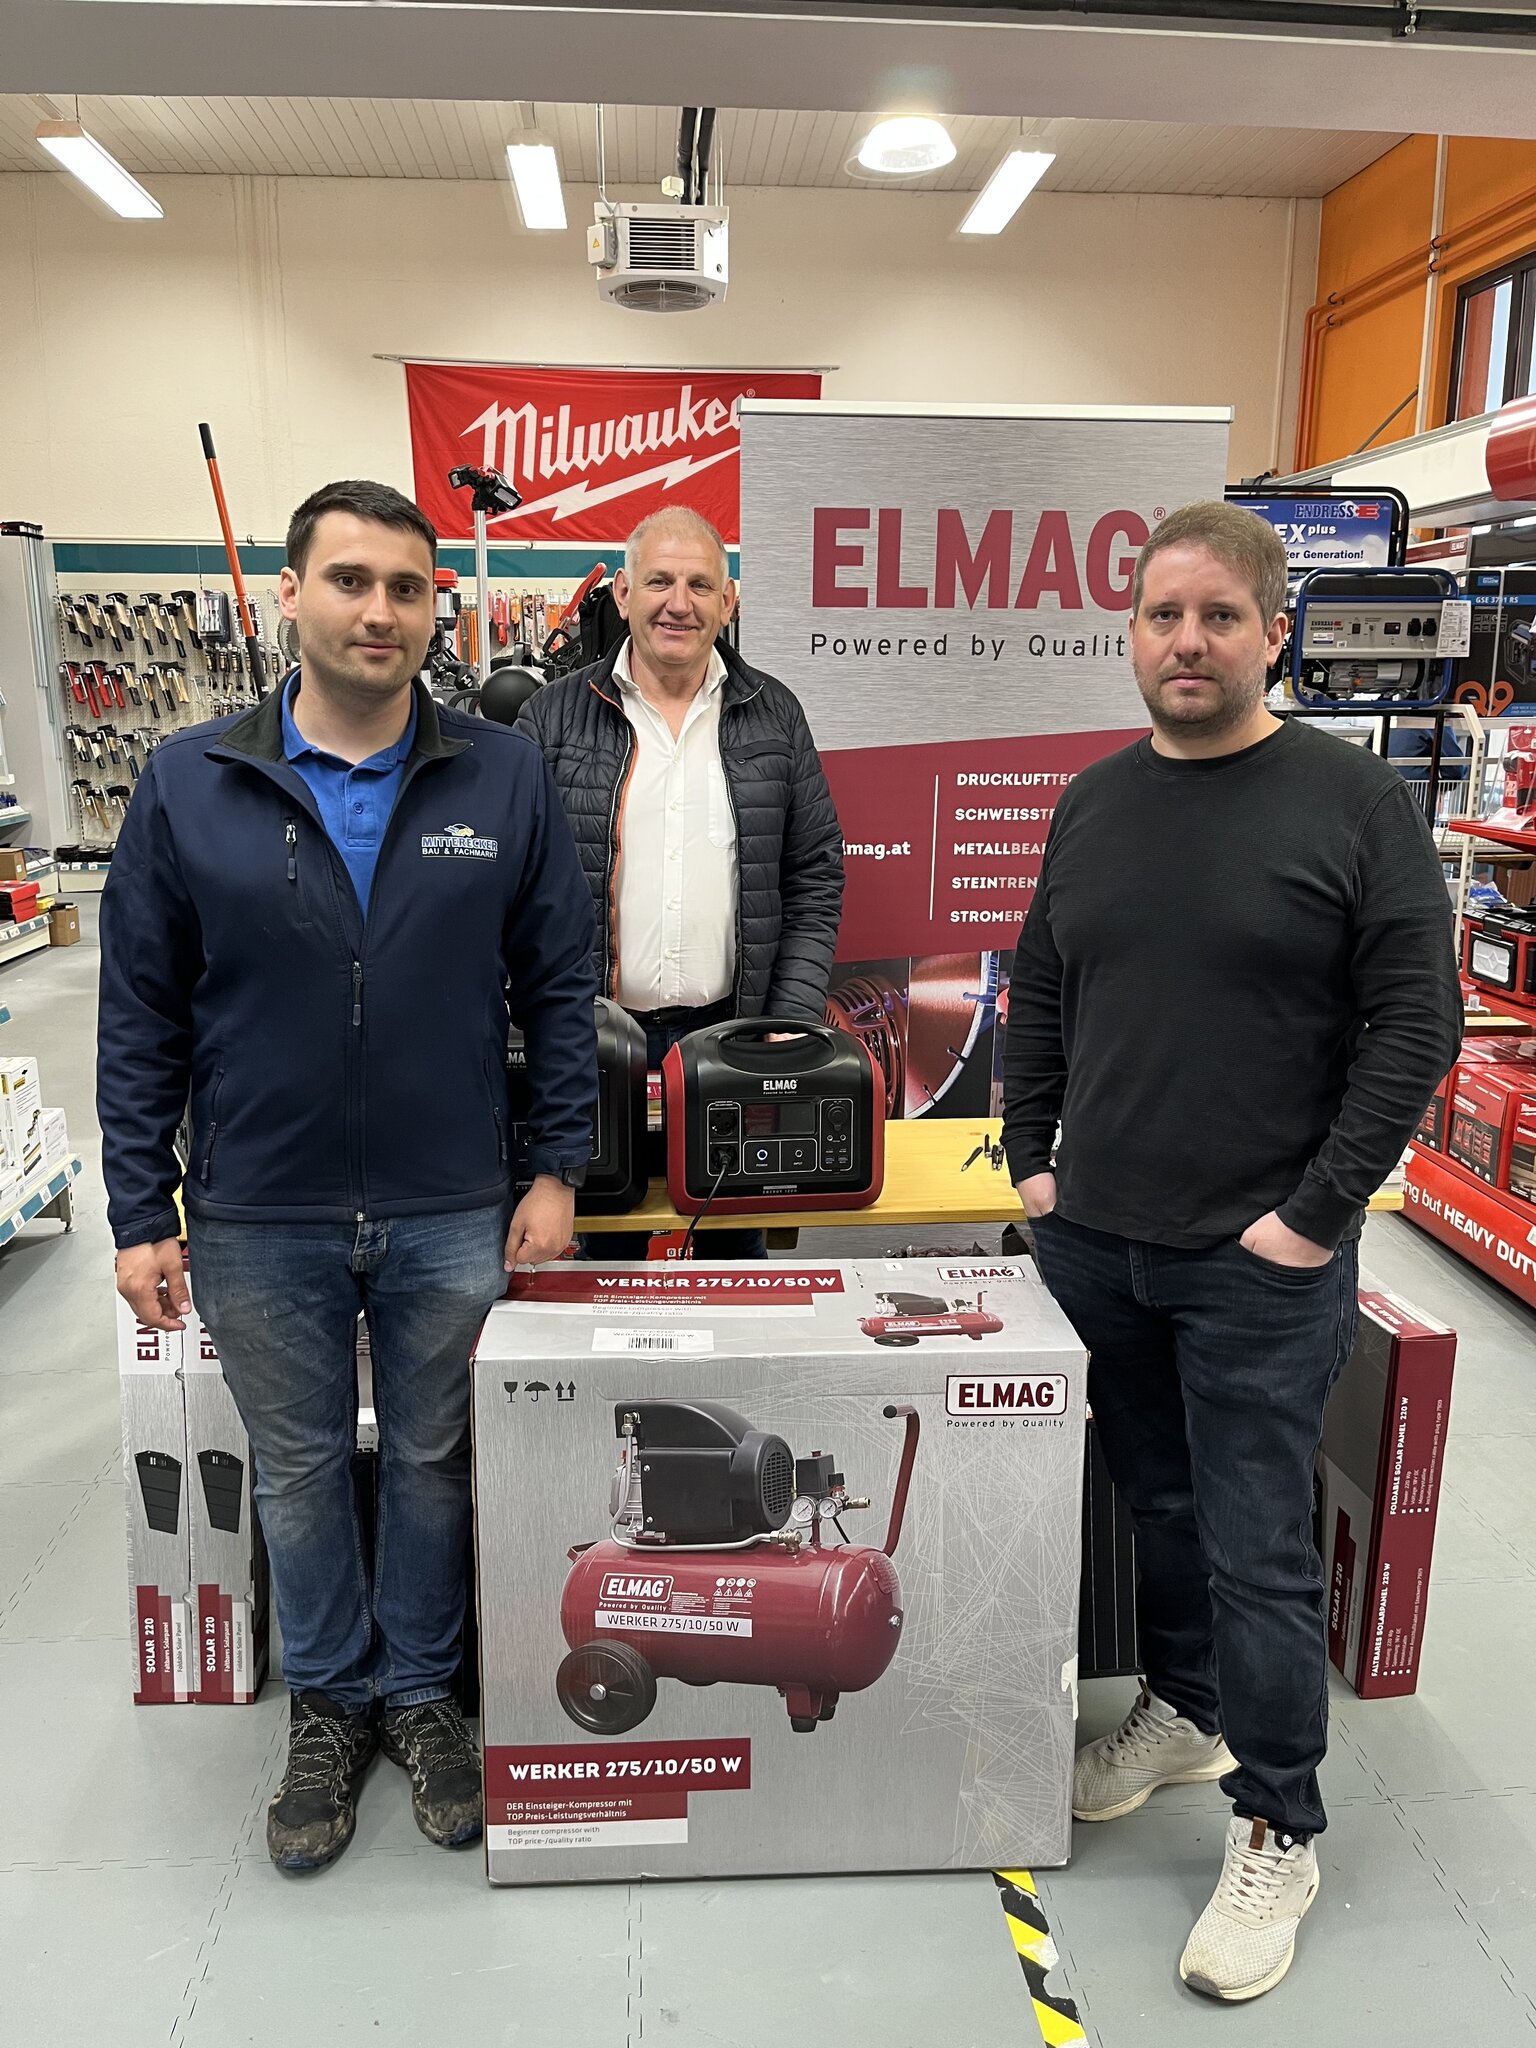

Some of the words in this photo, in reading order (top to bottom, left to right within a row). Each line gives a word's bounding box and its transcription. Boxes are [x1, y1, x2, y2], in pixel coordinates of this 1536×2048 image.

[1295, 504, 1355, 519] ENDRESS
[1274, 524, 1306, 544] EX
[1308, 524, 1336, 536] plus
[812, 508, 1151, 611] ELMAG
[1304, 550, 1363, 559] Generation!
[811, 633, 948, 656] Powered
[971, 634, 1005, 661] by
[1028, 634, 1125, 659] Qualit
[422, 836, 498, 851] MITTERECKER
[841, 839, 911, 860] lmag.at
[454, 848, 497, 858] FACHMARKT
[951, 877, 1037, 890] STEINTREN
[950, 911, 1027, 923] STROMER
[763, 1080, 797, 1090] ELMAG
[1402, 1179, 1420, 1204] ing
[1422, 1188, 1442, 1216] but
[1443, 1203, 1496, 1250] HEAVY
[1496, 1238, 1536, 1282] DUTY
[947, 1268, 1014, 1278] ELMAG
[596, 1278, 690, 1288] WERKER
[696, 1277, 810, 1288] 275/10/50
[815, 1277, 836, 1286] W
[136, 1319, 159, 1360] ELM
[958, 1382, 1054, 1407] ELMAG
[1401, 1396, 1408, 1405] W
[1400, 1406, 1408, 1420] 220
[947, 1420, 995, 1428] Powered
[1003, 1420, 1015, 1428] by
[1023, 1419, 1064, 1428] Quality
[1398, 1423, 1406, 1448] PANEL
[1394, 1449, 1404, 1475] SOLAR
[1390, 1476, 1401, 1515] FOLDABLE
[1335, 1562, 1343, 1586] 220
[607, 1578, 664, 1597] ELMAG
[1332, 1589, 1341, 1631] SOLAR
[144, 1617, 154, 1635] 220
[205, 1616, 215, 1634] 220
[607, 1614, 658, 1627] WERKER
[661, 1618, 723, 1631] 275/10/50
[727, 1621, 739, 1632] W
[1371, 1637, 1383, 1677] FALTBARES
[1377, 1587, 1388, 1636] SOLARPANEL
[1384, 1562, 1390, 1570] W
[162, 1622, 170, 1649] Solarpanel
[146, 1640, 156, 1673] SOLAR
[206, 1638, 216, 1672] SOLAR
[508, 1762, 600, 1780] WERKER
[605, 1757, 716, 1778] 275/10/50
[721, 1756, 742, 1772] W
[507, 1802, 523, 1810] DER
[526, 1800, 616, 1810] Einsteiger-Kompressor
[525, 1810, 626, 1820] Preis-Leistungsverhältnis
[541, 1828, 582, 1836] compressor
